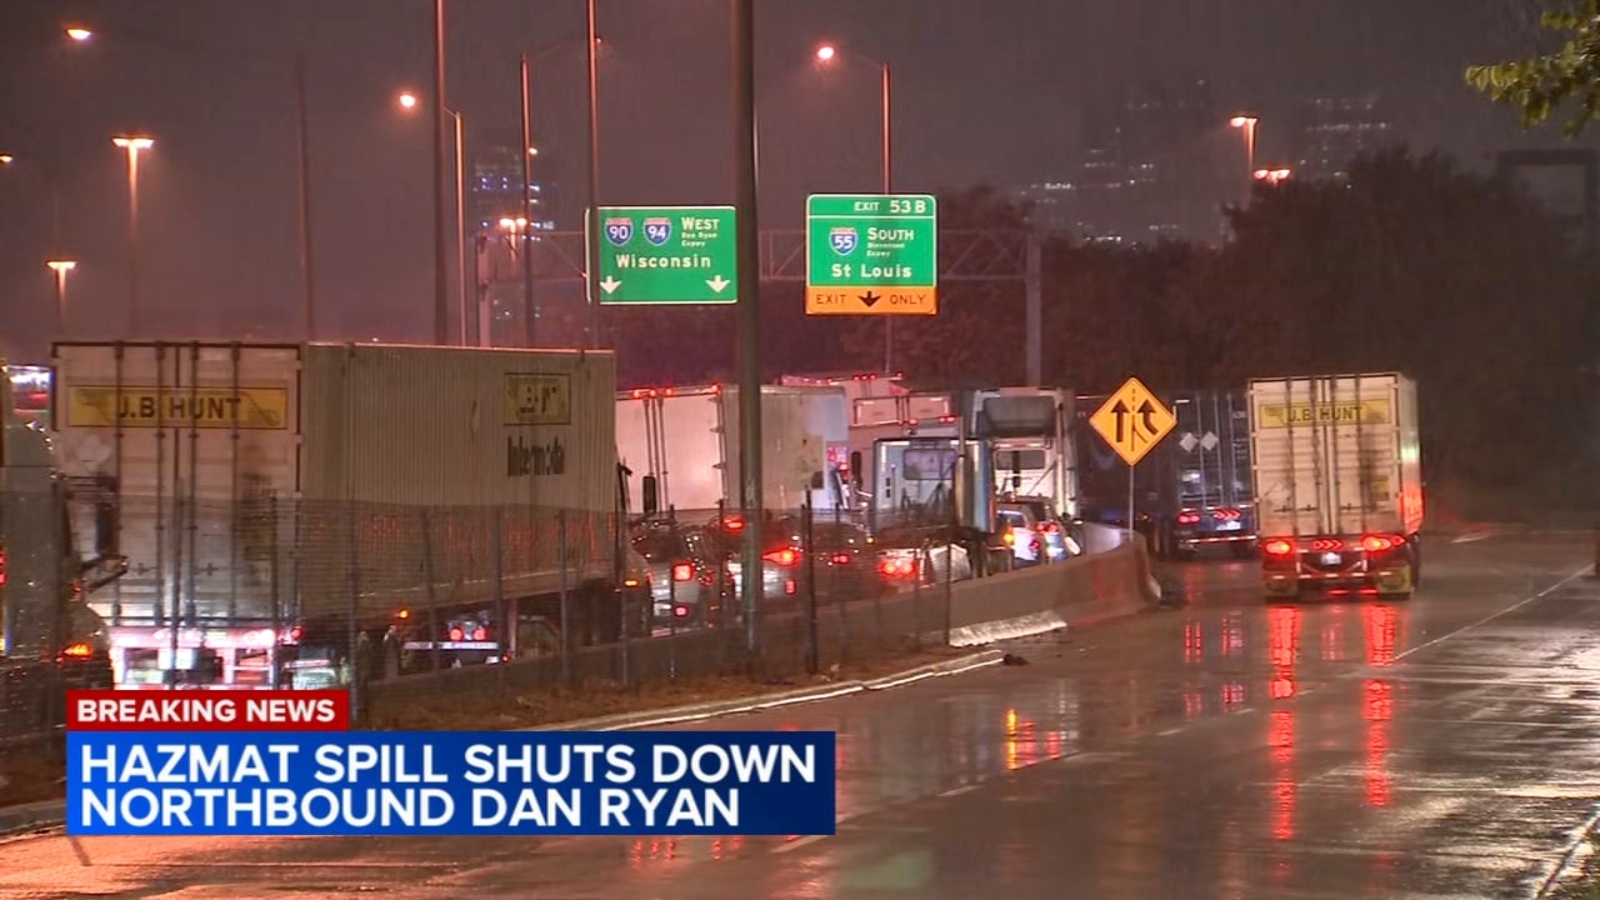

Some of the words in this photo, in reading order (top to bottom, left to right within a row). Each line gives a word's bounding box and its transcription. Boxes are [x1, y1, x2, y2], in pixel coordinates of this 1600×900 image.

[854, 201, 880, 211] EXIT
[890, 200, 911, 213] 53
[915, 200, 926, 213] B
[680, 217, 719, 230] WEST
[609, 226, 629, 240] 90
[647, 226, 667, 240] 94
[867, 227, 914, 241] SOUTH
[834, 235, 854, 250] 55
[615, 253, 711, 268] Wisconsin
[831, 263, 852, 278] St
[860, 264, 912, 278] Louis
[816, 294, 847, 304] EXIT
[889, 294, 927, 305] ONLY
[118, 396, 160, 419] J.B
[169, 397, 241, 420] HUNT
[1319, 406, 1362, 421] HUNT
